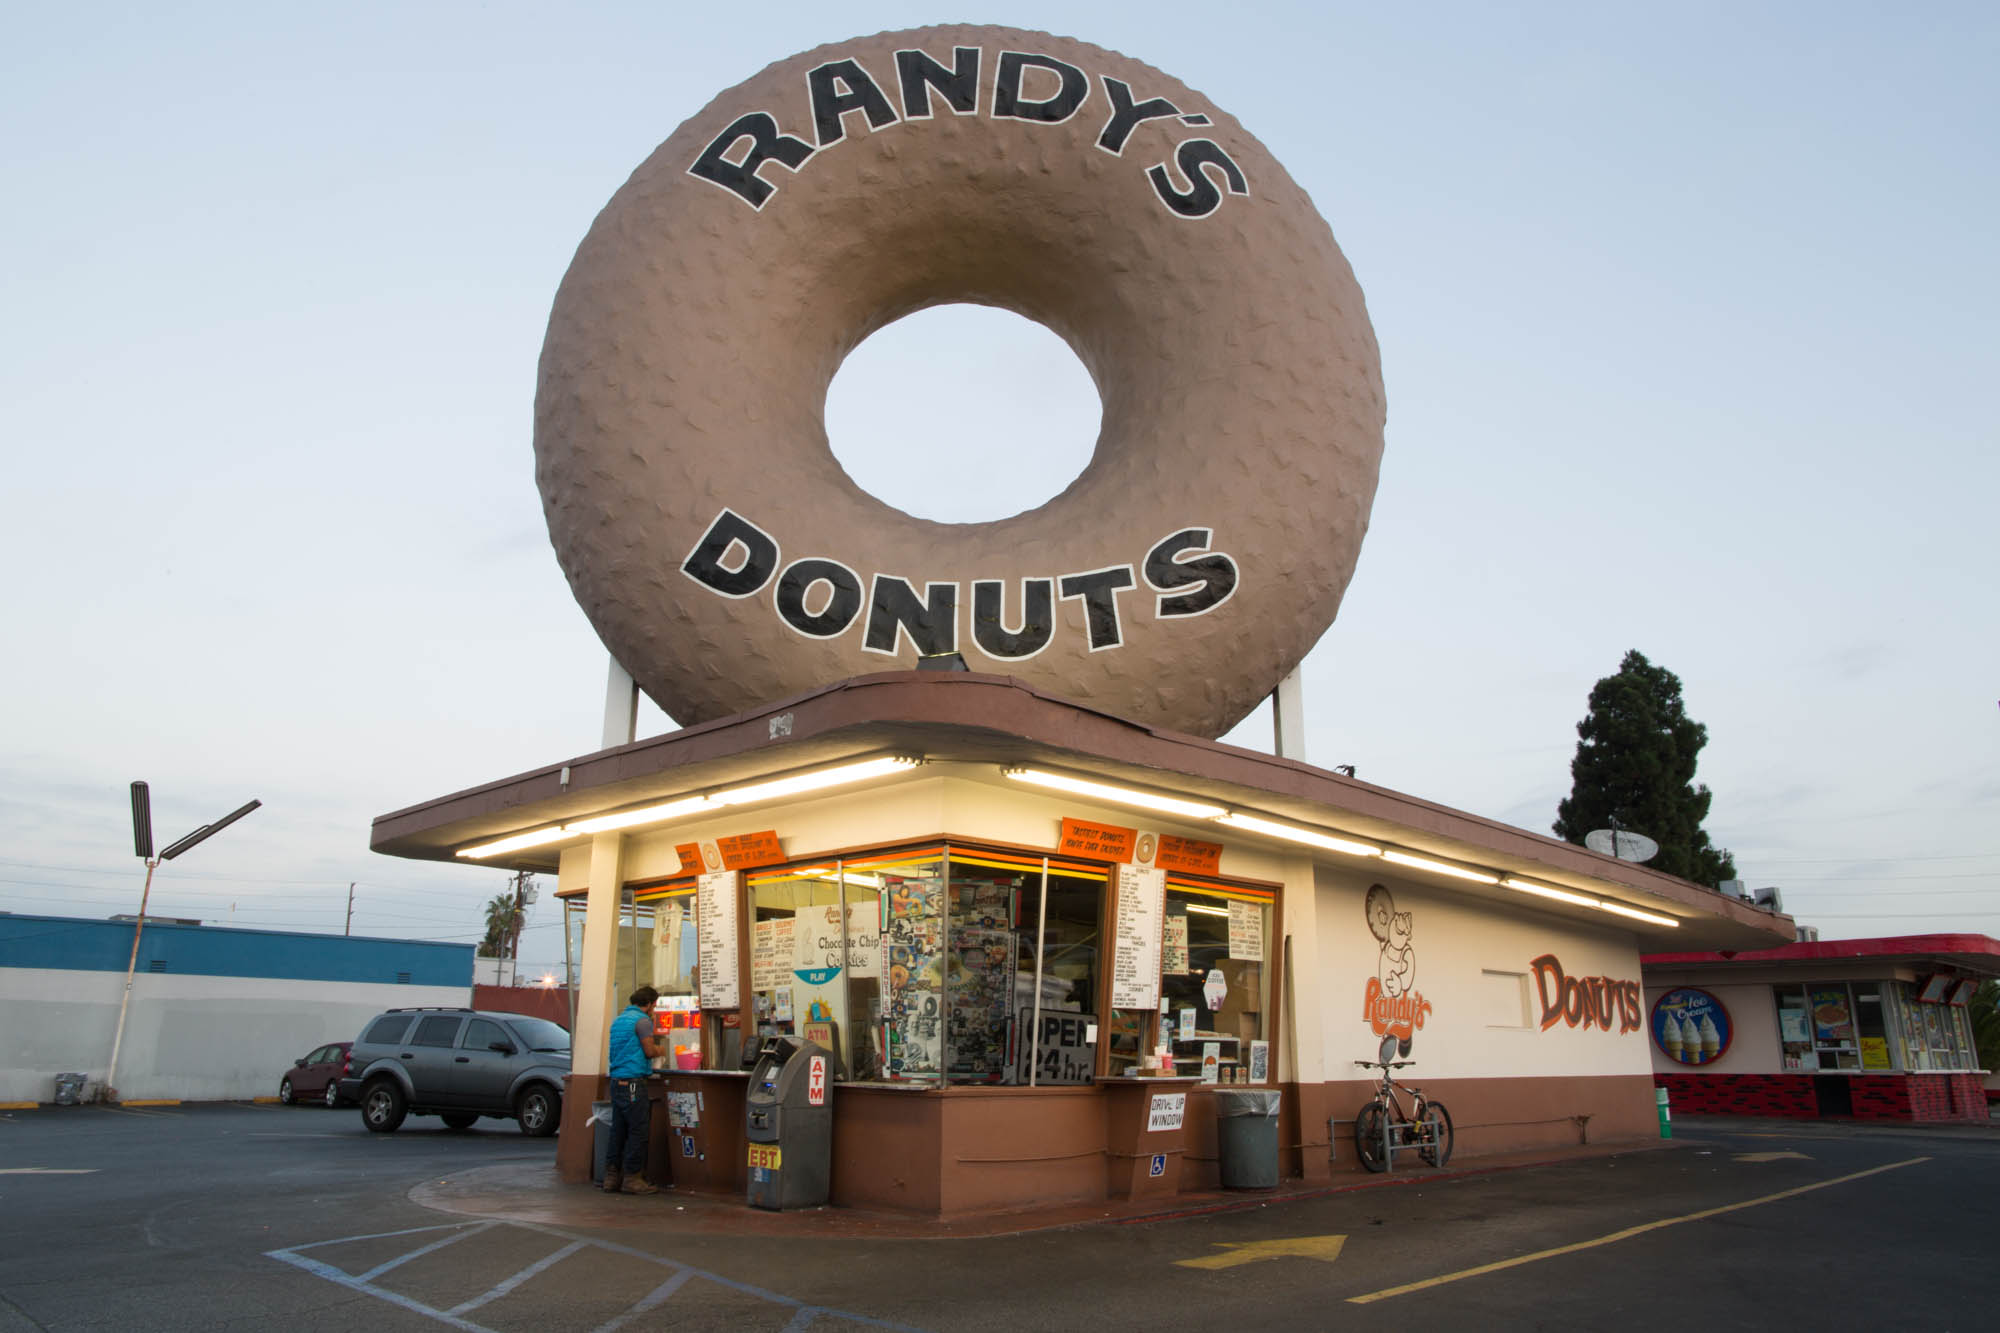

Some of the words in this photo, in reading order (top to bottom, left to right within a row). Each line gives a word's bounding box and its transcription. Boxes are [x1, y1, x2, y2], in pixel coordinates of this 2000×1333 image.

[686, 46, 1249, 219] RANDY'S
[680, 507, 1240, 662] DONUTS
[859, 935, 880, 949] Chip
[809, 972, 826, 982] PLAY
[1363, 977, 1432, 1040] Randy's
[1688, 996, 1708, 1009] Ice
[1677, 1006, 1713, 1020] Cream
[807, 1029, 829, 1041] ATM
[1027, 1016, 1093, 1048] OPEN
[810, 1061, 823, 1100] ATM
[1176, 1097, 1185, 1110] UP
[1152, 1113, 1184, 1126] WINDOW
[750, 1149, 778, 1168] EBT
